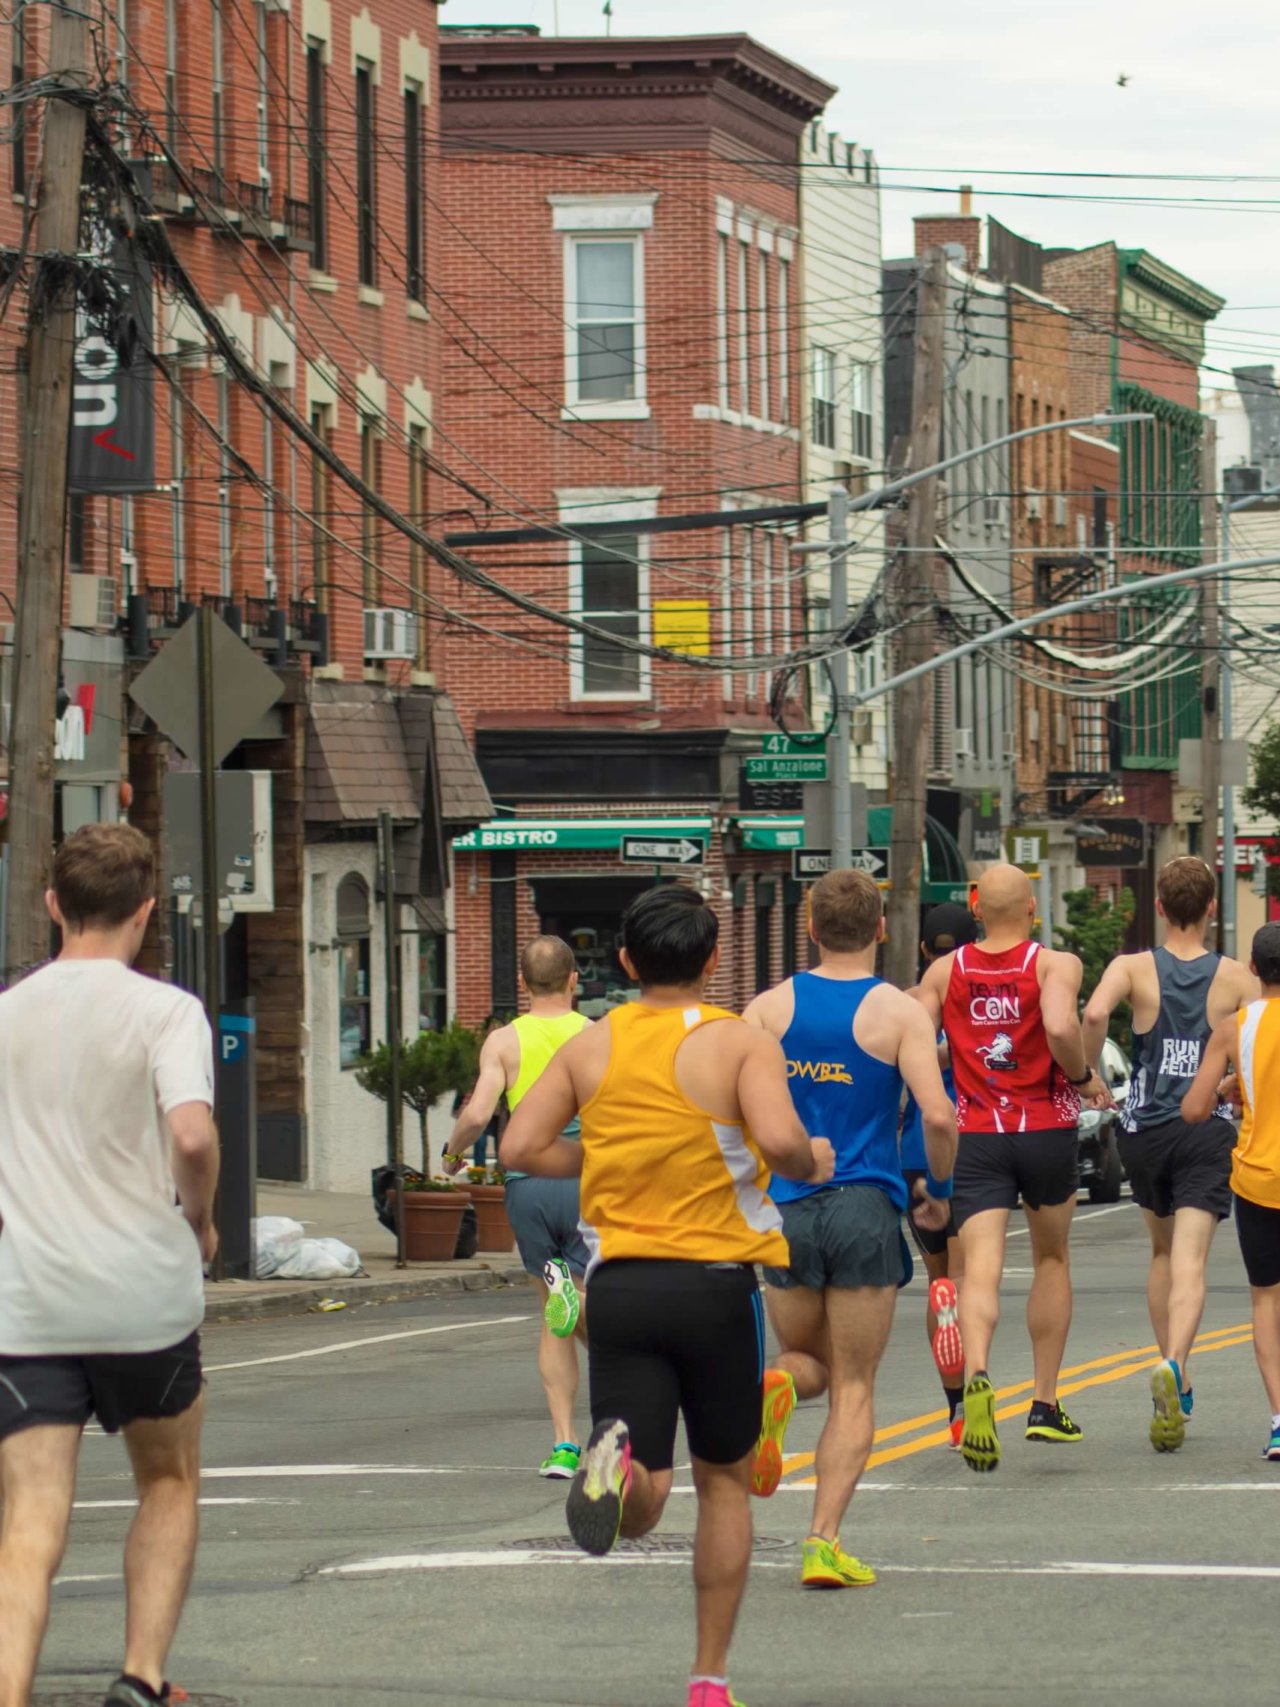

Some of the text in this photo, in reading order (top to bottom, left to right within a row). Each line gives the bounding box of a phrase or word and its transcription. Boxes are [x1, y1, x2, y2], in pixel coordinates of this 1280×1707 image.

[767, 736, 790, 753] 47
[750, 760, 823, 772] Sal Anzalone
[481, 830, 557, 846] BISTRO
[633, 844, 693, 857] ONE WAY
[807, 858, 832, 870] ONE
[968, 981, 1019, 998] team
[222, 1035, 239, 1059] P
[1162, 1038, 1200, 1057] RUN
[1159, 1058, 1199, 1078] HELL
